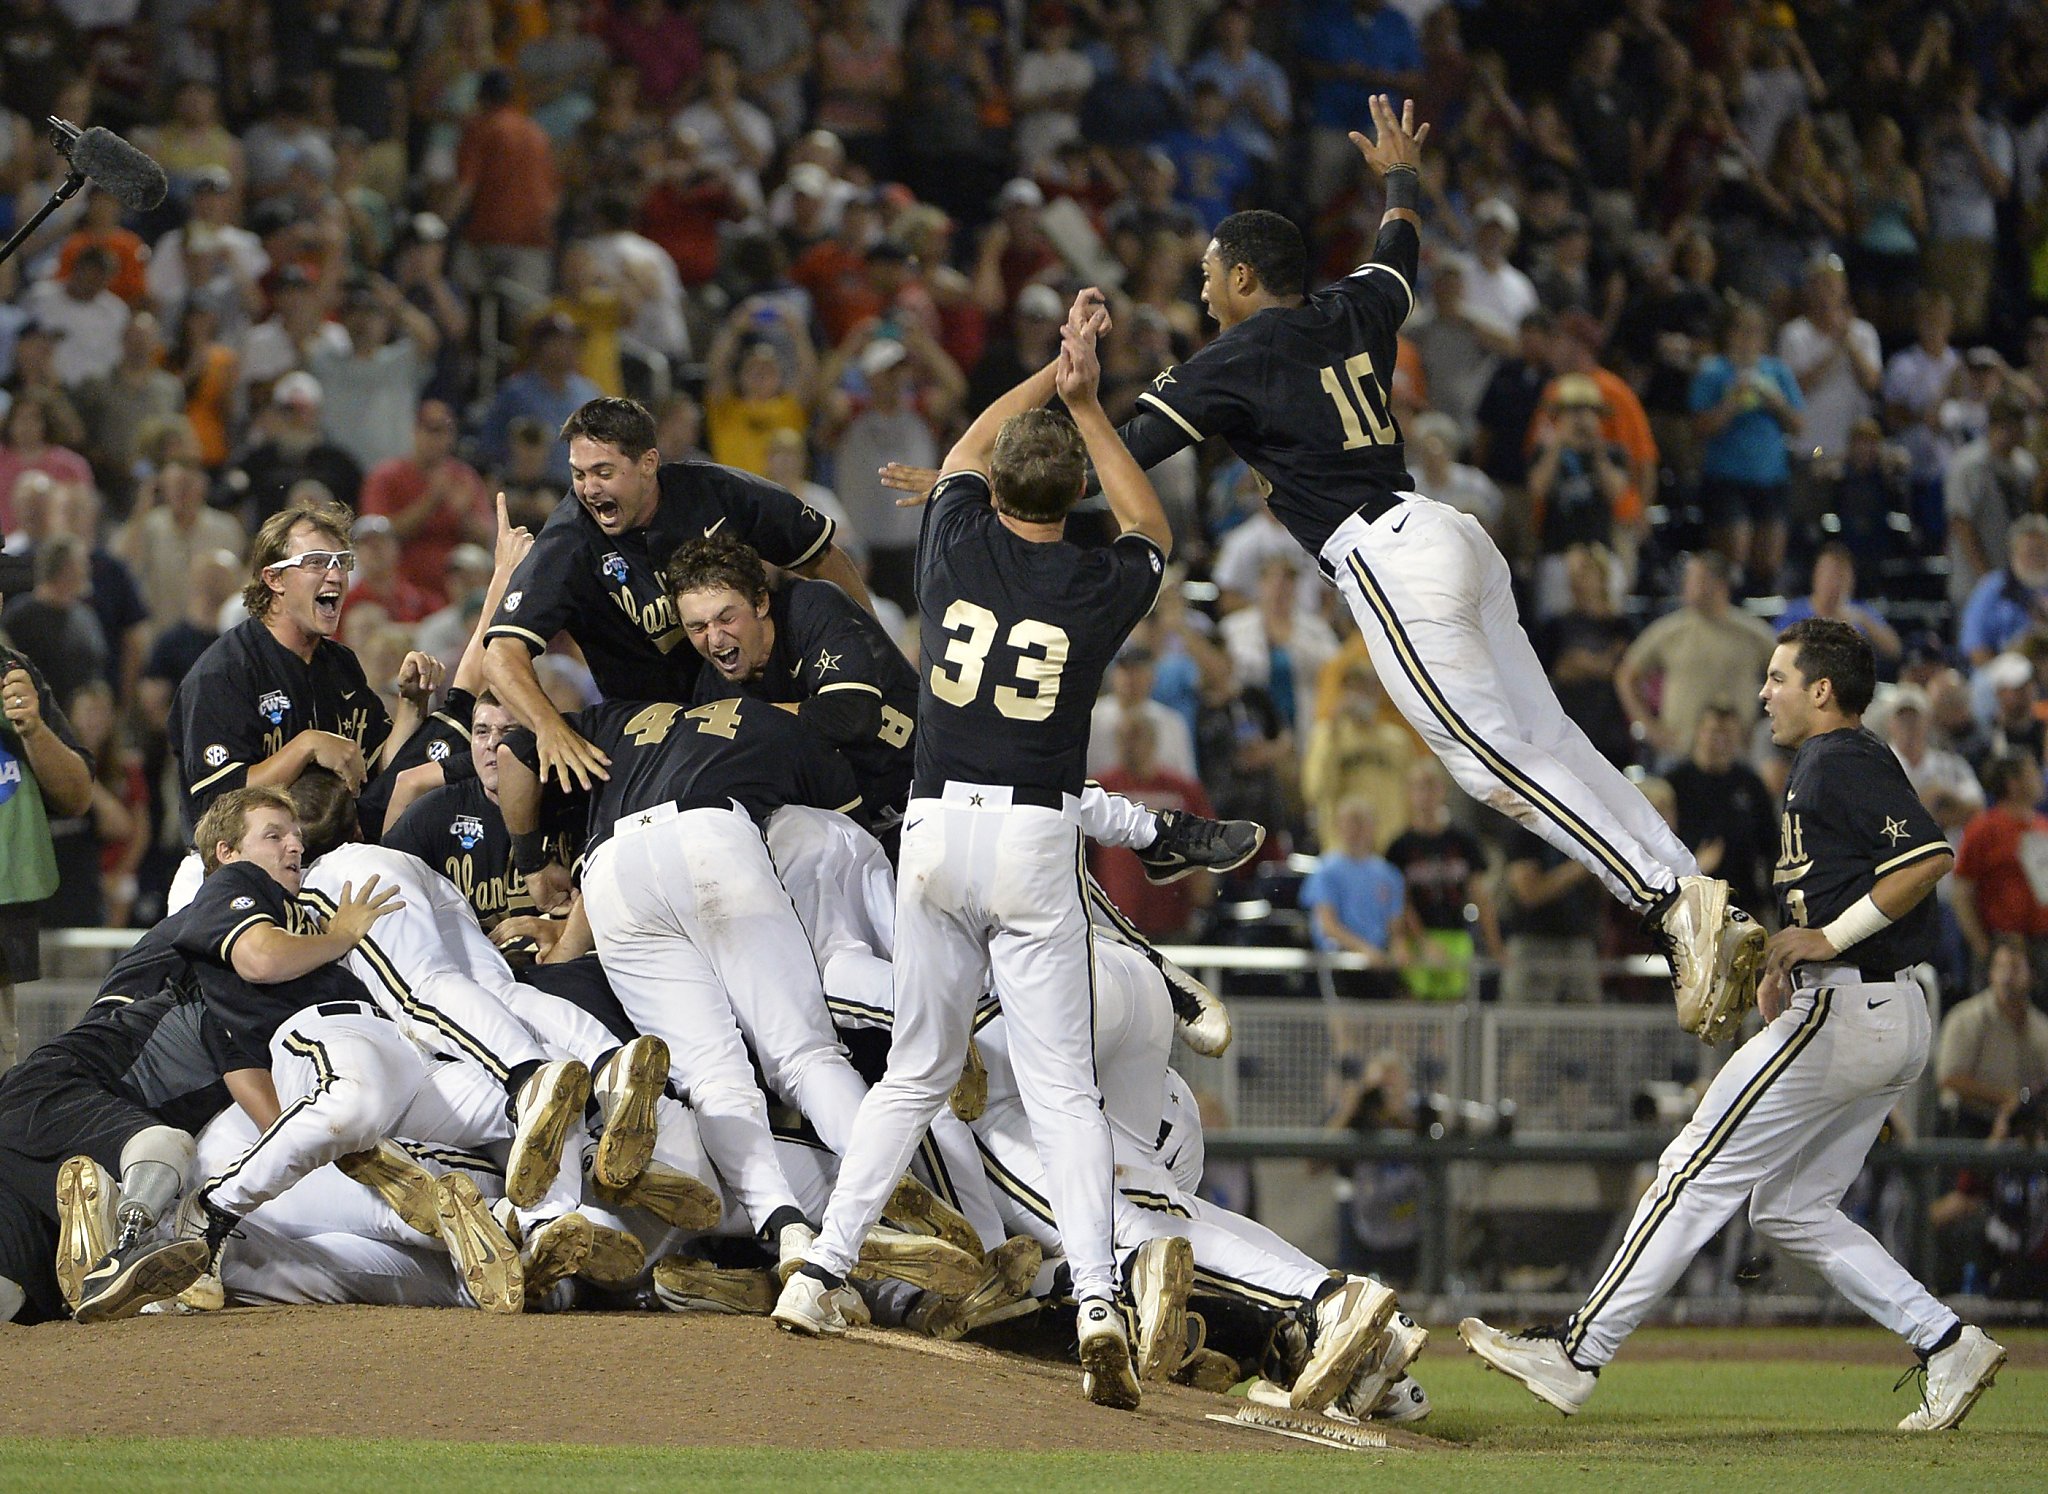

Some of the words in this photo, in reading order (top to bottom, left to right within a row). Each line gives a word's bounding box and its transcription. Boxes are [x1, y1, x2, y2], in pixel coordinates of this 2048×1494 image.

[1319, 351, 1396, 451] 10
[929, 599, 1071, 722] 33
[258, 695, 292, 717] CWS
[624, 697, 743, 746] 44
[205, 745, 228, 767] SEC
[449, 821, 485, 841] CWS
